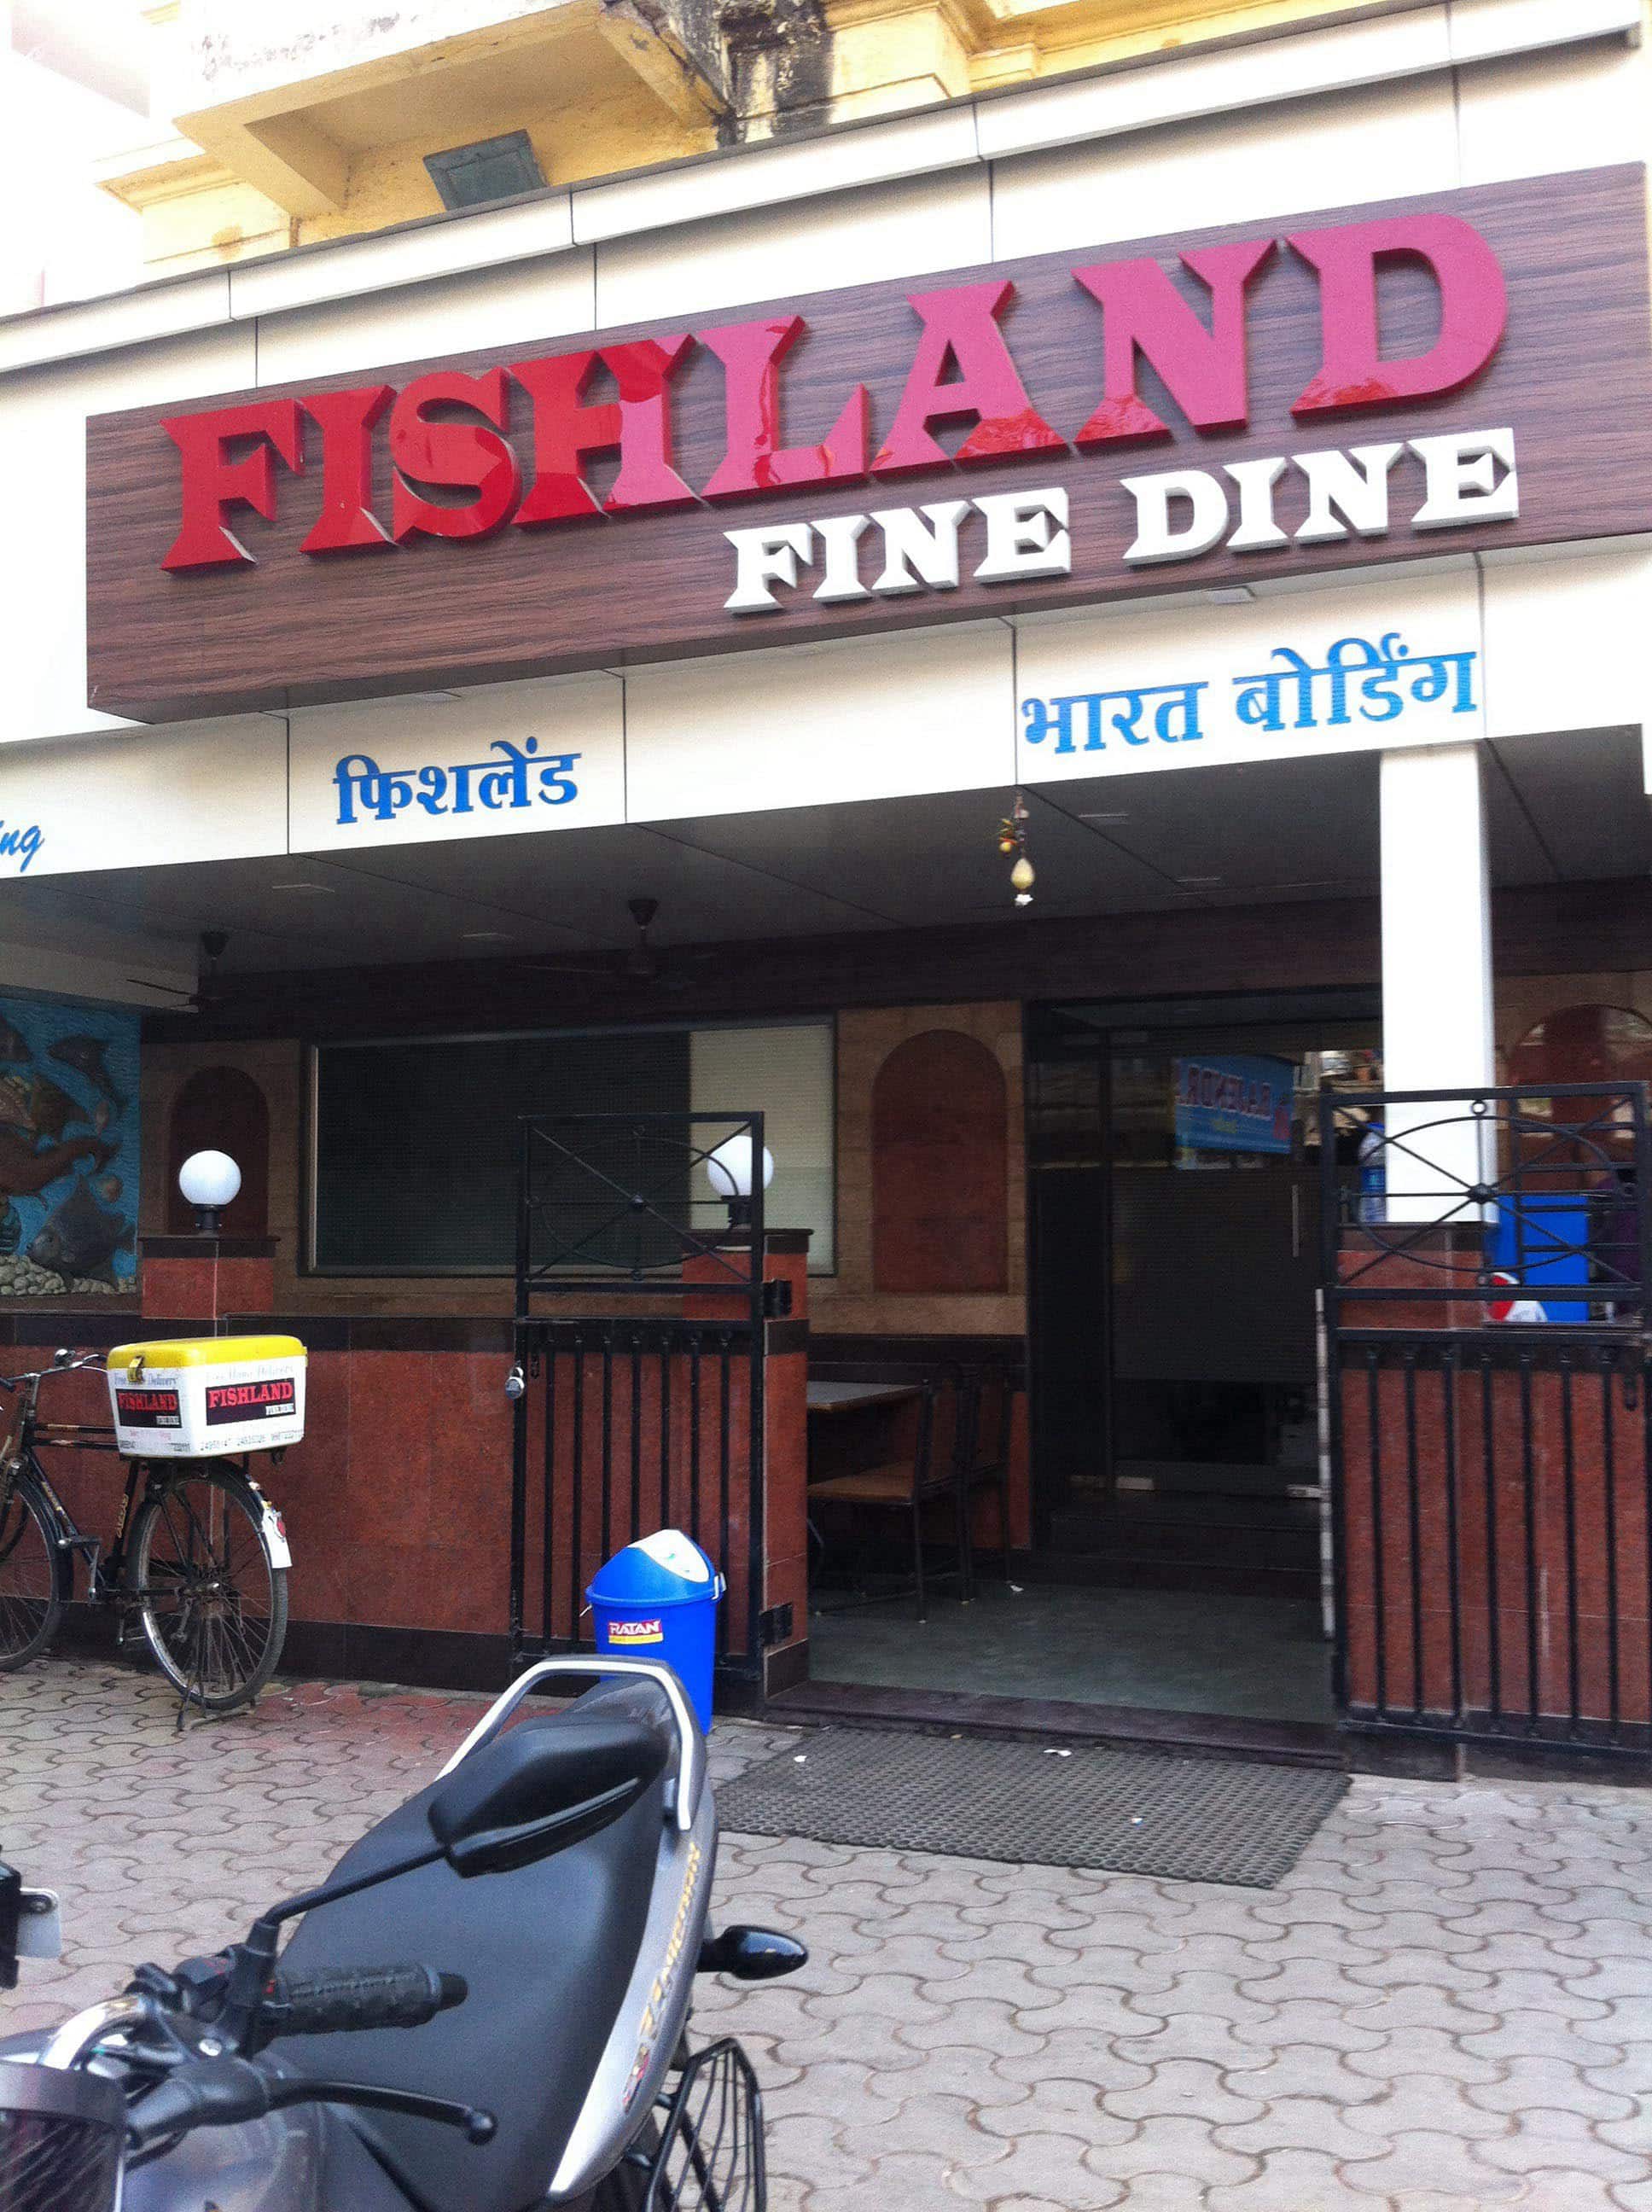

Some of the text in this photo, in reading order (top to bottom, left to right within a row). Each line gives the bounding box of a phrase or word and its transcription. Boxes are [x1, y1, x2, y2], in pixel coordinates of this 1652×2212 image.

[160, 212, 1509, 573] FISHLAND
[724, 427, 1519, 614] FINE DINE
[1021, 632, 1477, 754] भारत बोर्डिंग
[332, 736, 582, 824] फिशलेंड
[118, 1393, 177, 1411] FISHLAND
[208, 1382, 293, 1408] FISHLAND
[609, 1620, 660, 1634] RATAN
